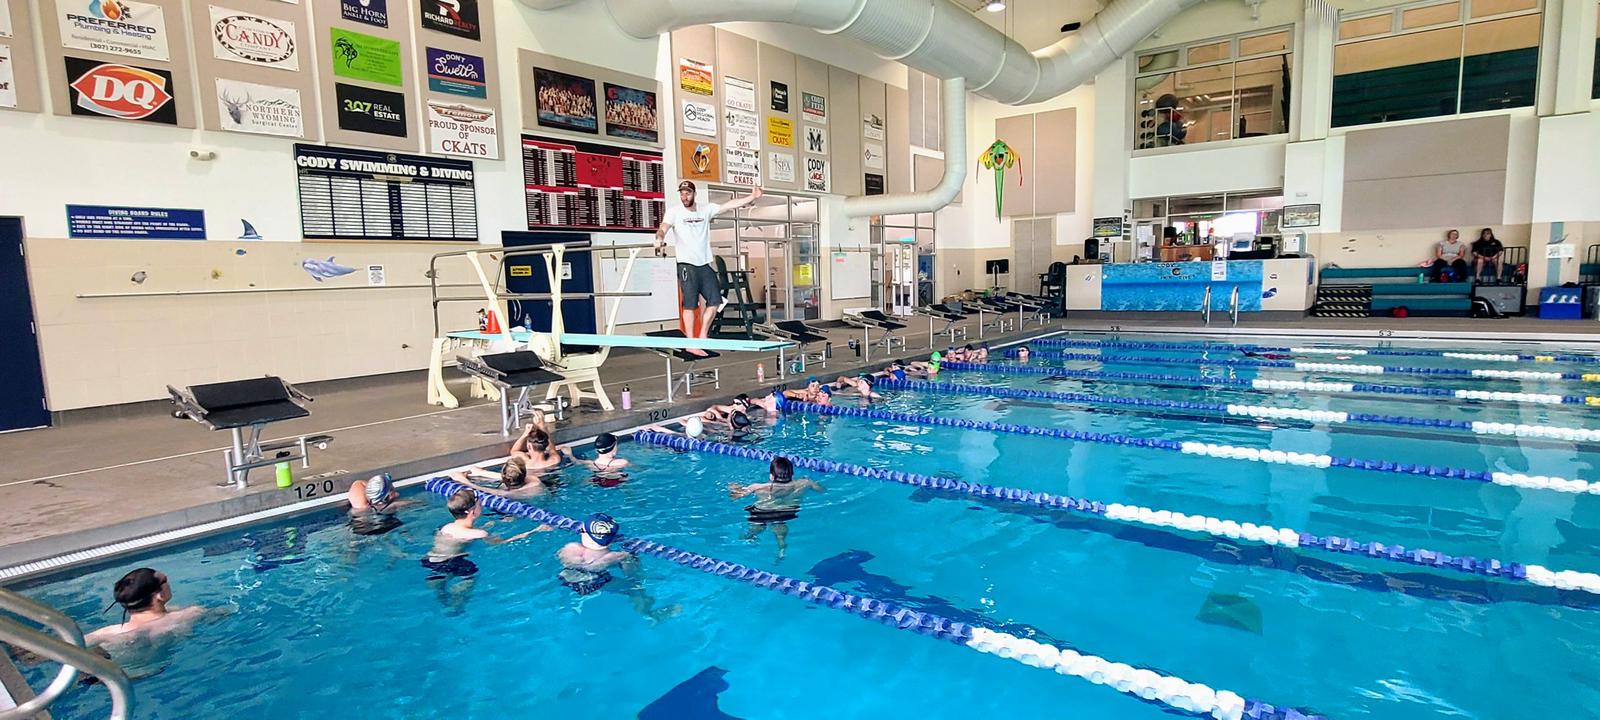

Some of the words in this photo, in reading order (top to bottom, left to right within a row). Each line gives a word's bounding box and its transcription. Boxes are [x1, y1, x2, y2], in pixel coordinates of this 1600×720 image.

[343, 3, 358, 12] BIG
[360, 8, 386, 19] HORN
[344, 11, 362, 19] ANKLE
[66, 14, 156, 34] PREFERRED
[424, 12, 454, 25] RICHARD
[74, 22, 112, 34] Plumbing
[121, 30, 152, 40] Heating
[226, 24, 284, 48] CANDY
[90, 42, 109, 51] (307)
[92, 74, 154, 110] DQ
[246, 104, 300, 117] NORTHERN
[344, 99, 372, 113] 307
[374, 104, 392, 112] REAL
[252, 112, 296, 124] WYOMING
[374, 111, 400, 120] ESTATE
[252, 120, 277, 128] Surgical
[429, 120, 458, 130] PROUD
[460, 124, 496, 136] SPONSOR
[458, 132, 470, 140] OF
[442, 140, 487, 156] CKATS
[297, 156, 336, 169] CODY
[340, 159, 418, 176] SWIMMING
[420, 166, 429, 176] &
[431, 168, 472, 180] DIVING
[808, 158, 825, 172] CODY
[734, 176, 754, 184] CKATS
